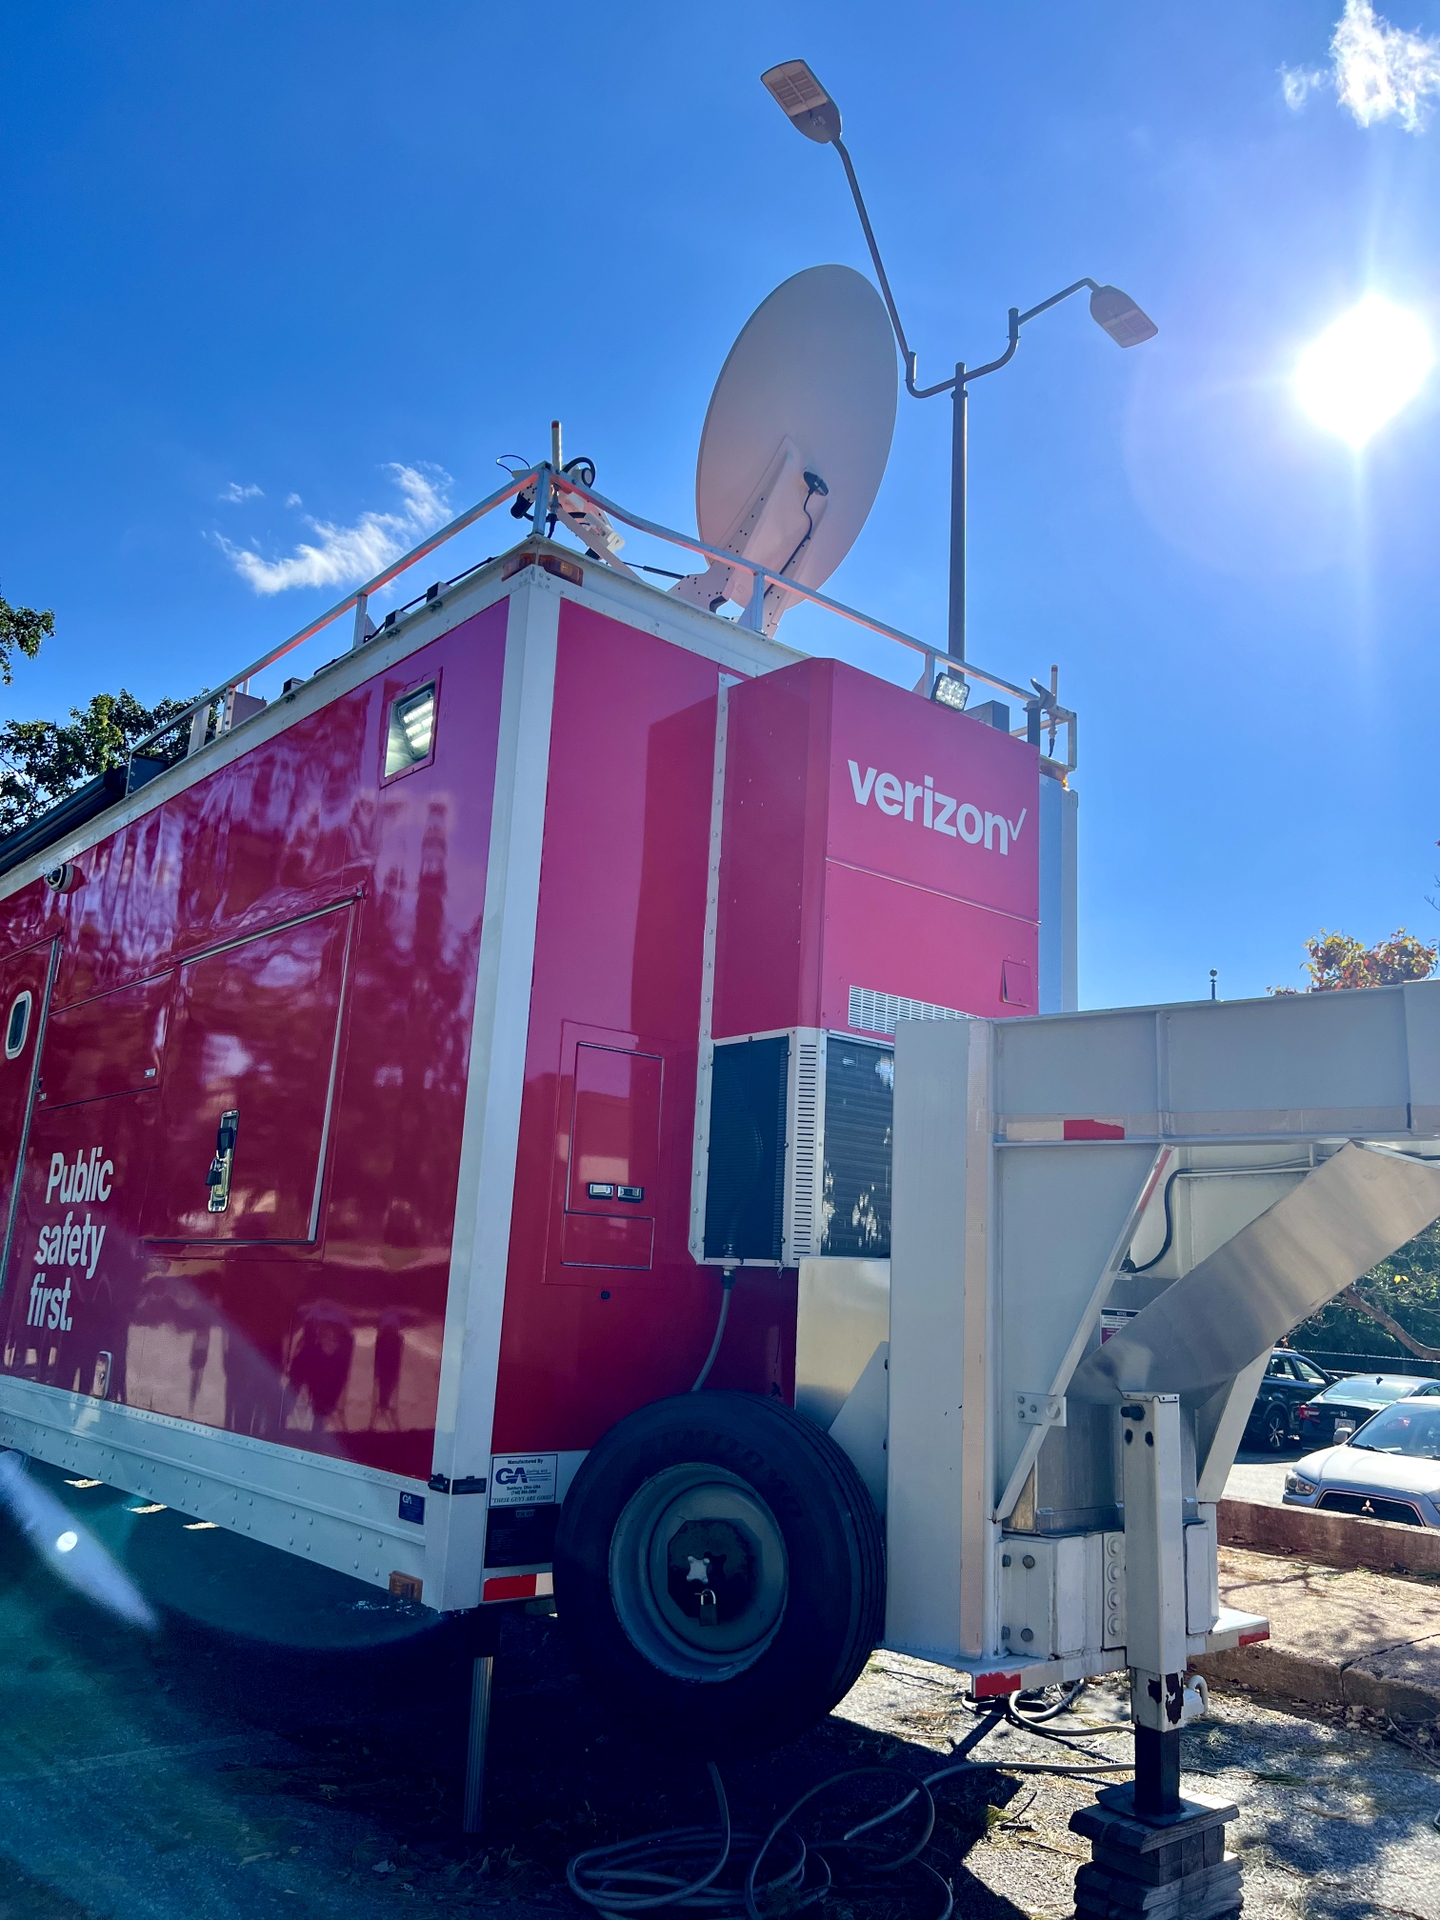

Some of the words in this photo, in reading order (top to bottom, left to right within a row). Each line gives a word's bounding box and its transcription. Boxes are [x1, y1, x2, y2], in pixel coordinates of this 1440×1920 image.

[847, 759, 1009, 856] verizon
[45, 1146, 114, 1204] Public
[36, 1211, 106, 1280] safety
[26, 1272, 73, 1331] first.
[496, 1467, 528, 1484] GA
